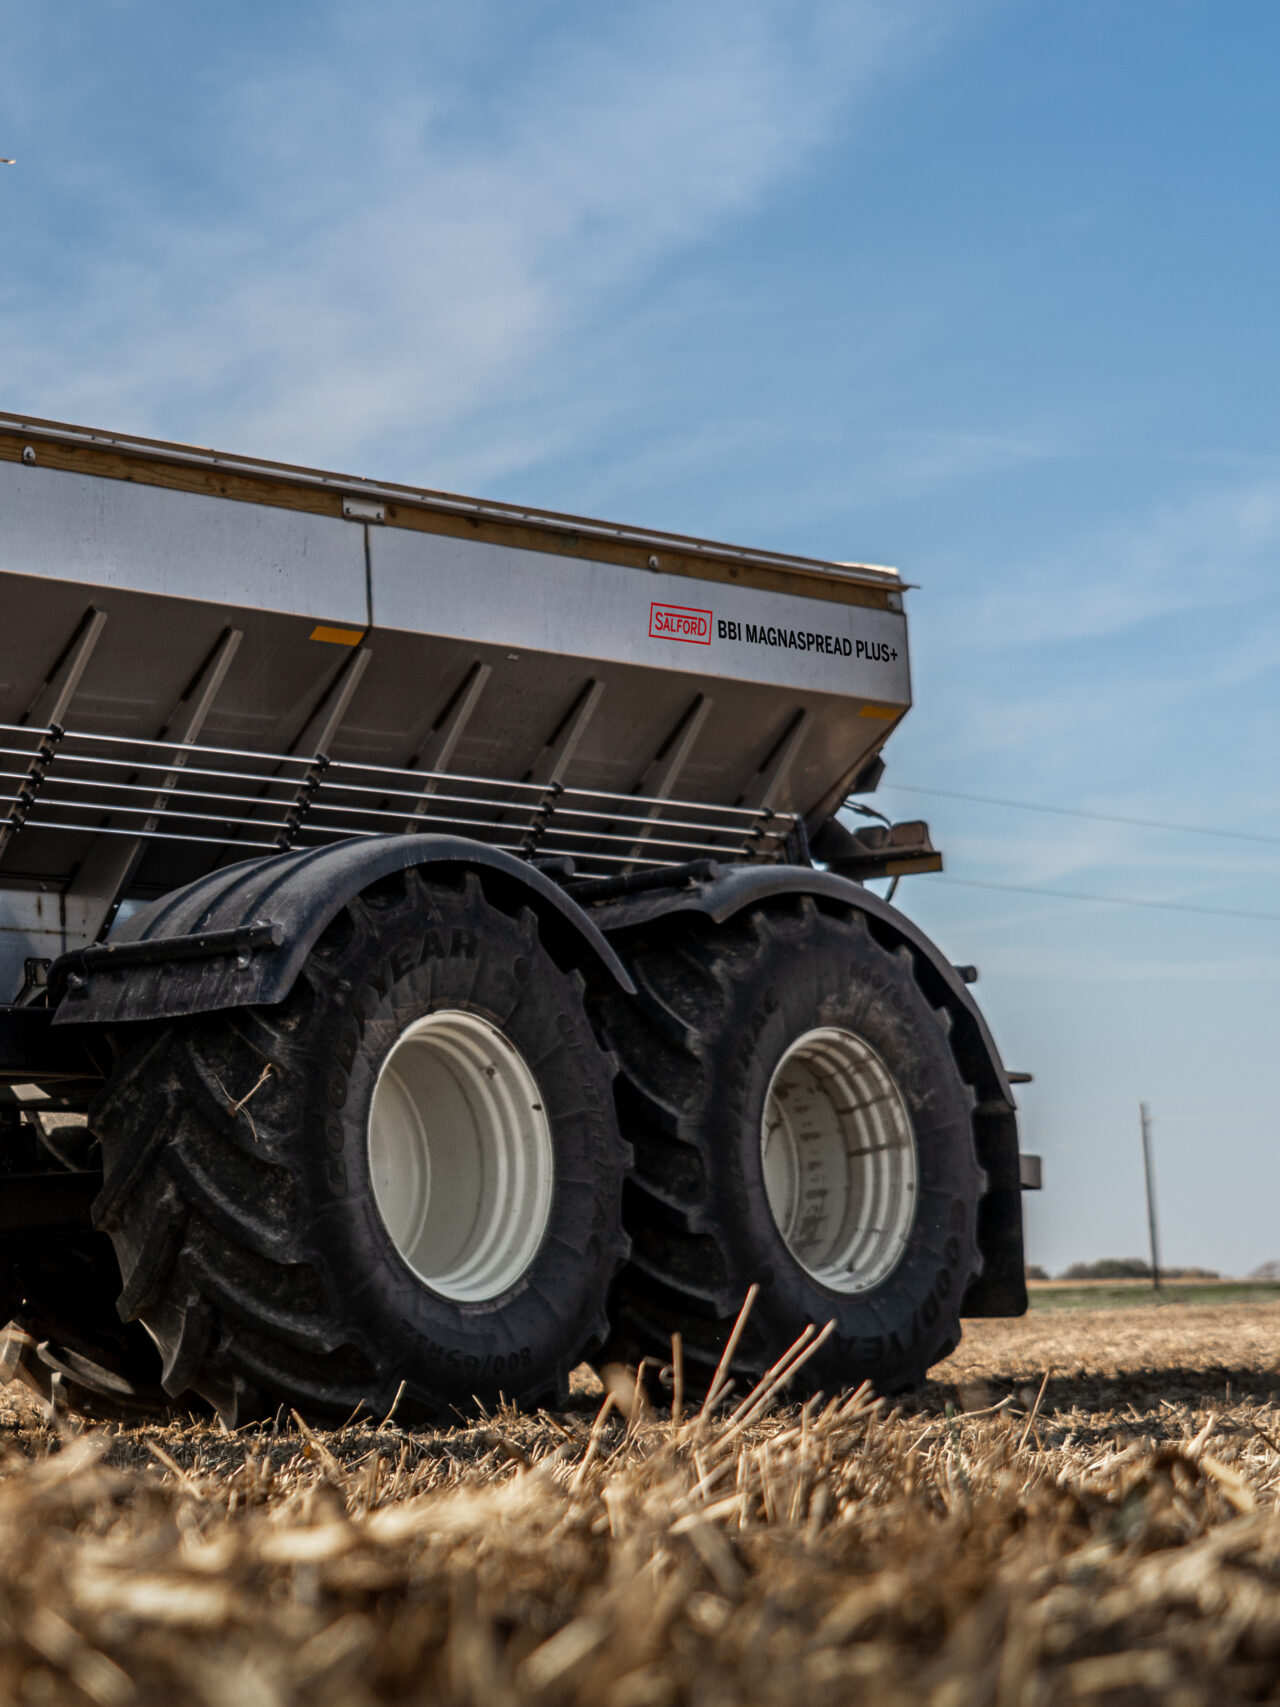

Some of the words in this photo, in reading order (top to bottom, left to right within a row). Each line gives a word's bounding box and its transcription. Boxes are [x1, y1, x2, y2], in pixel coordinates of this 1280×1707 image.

[655, 611, 707, 636] SALFORD
[718, 620, 741, 641] BBI
[746, 623, 852, 657] MAGNASPREAD
[856, 640, 898, 662] PLUS+
